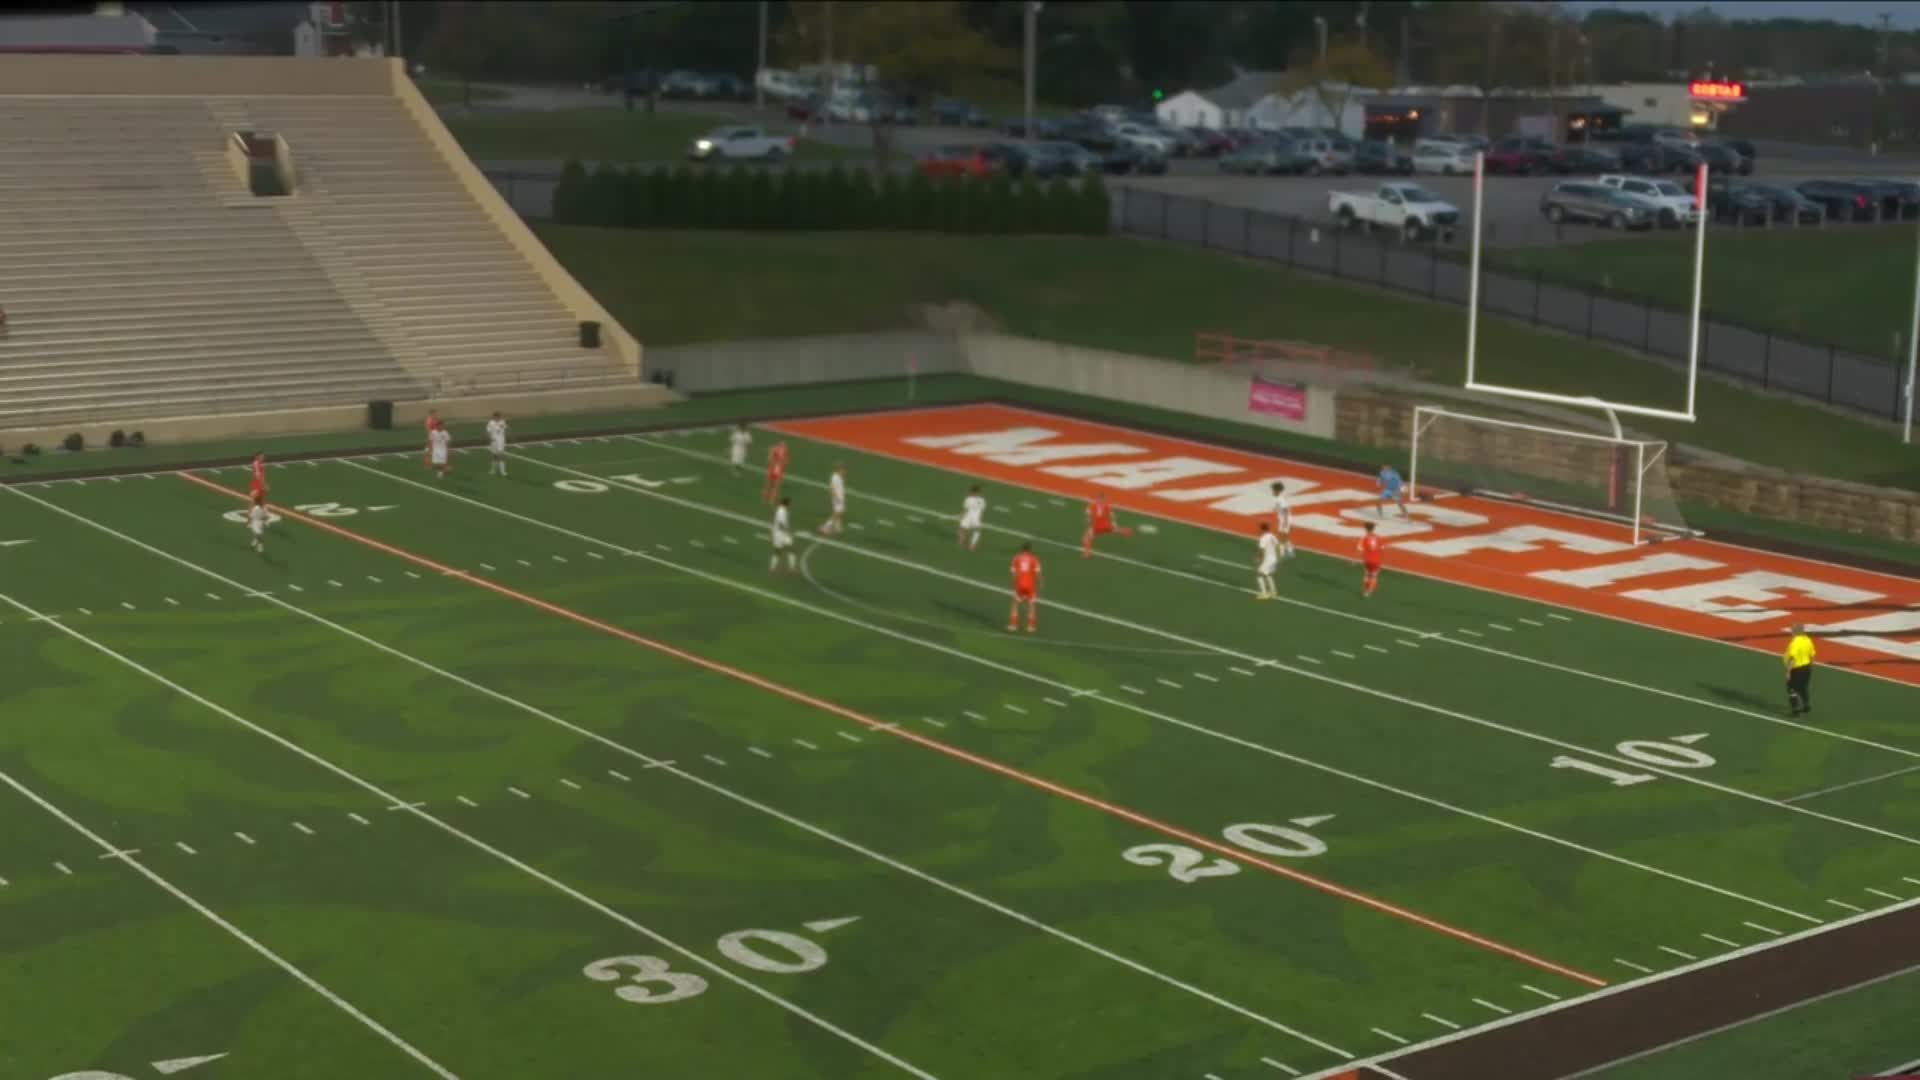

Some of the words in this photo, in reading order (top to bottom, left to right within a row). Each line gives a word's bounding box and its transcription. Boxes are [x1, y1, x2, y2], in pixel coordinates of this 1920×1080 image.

[1550, 740, 1717, 787] 10
[1121, 822, 1328, 883] 20
[583, 929, 828, 1004] 30
